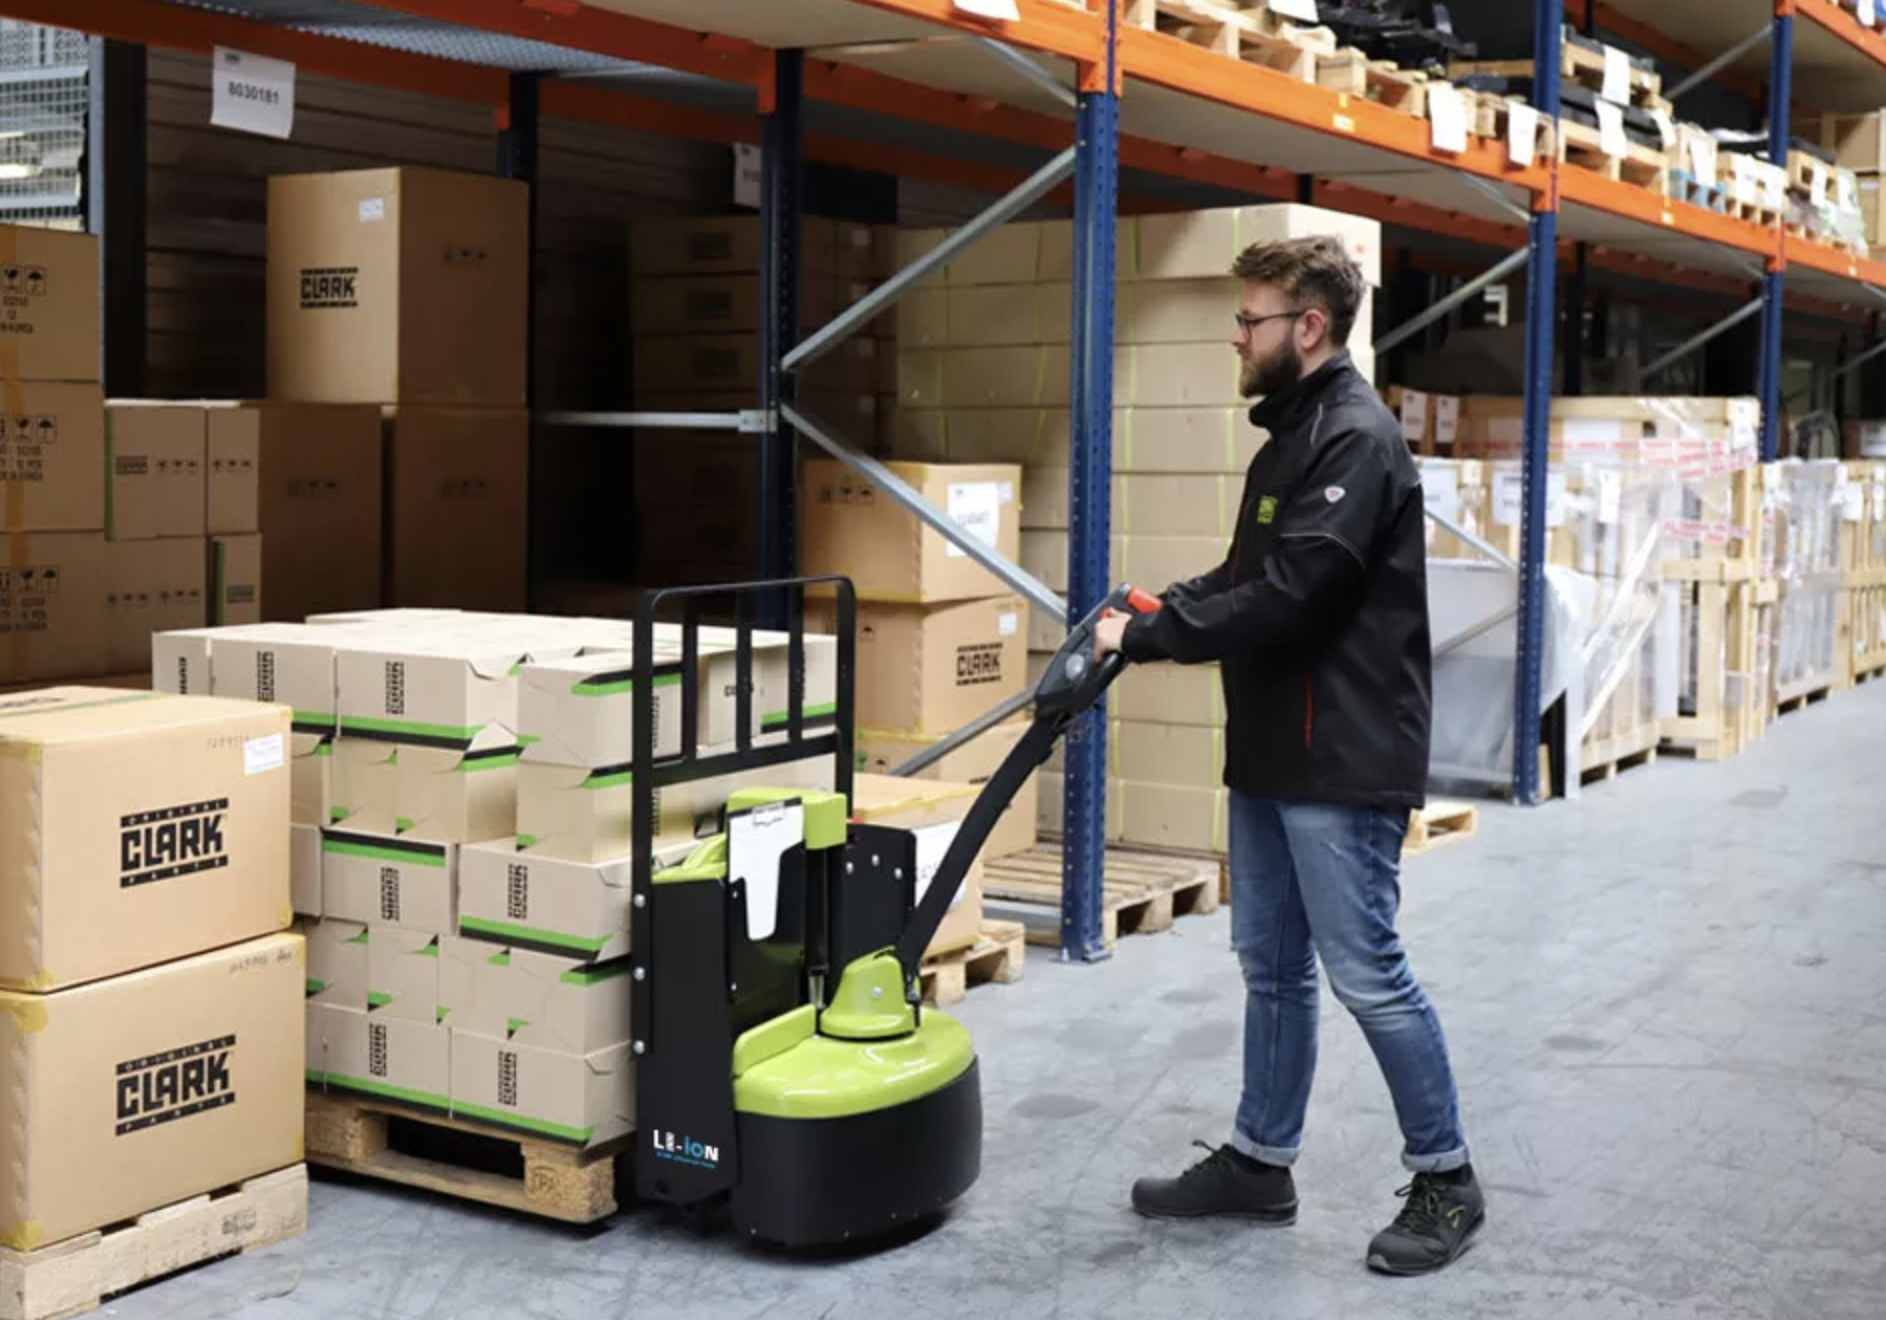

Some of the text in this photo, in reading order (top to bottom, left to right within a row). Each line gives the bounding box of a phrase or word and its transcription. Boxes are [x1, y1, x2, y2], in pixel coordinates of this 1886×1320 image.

[300, 275, 356, 300] CLARK
[957, 652, 1001, 677] CLARK
[120, 813, 223, 872] CLARK
[117, 1050, 229, 1120] CLARK
